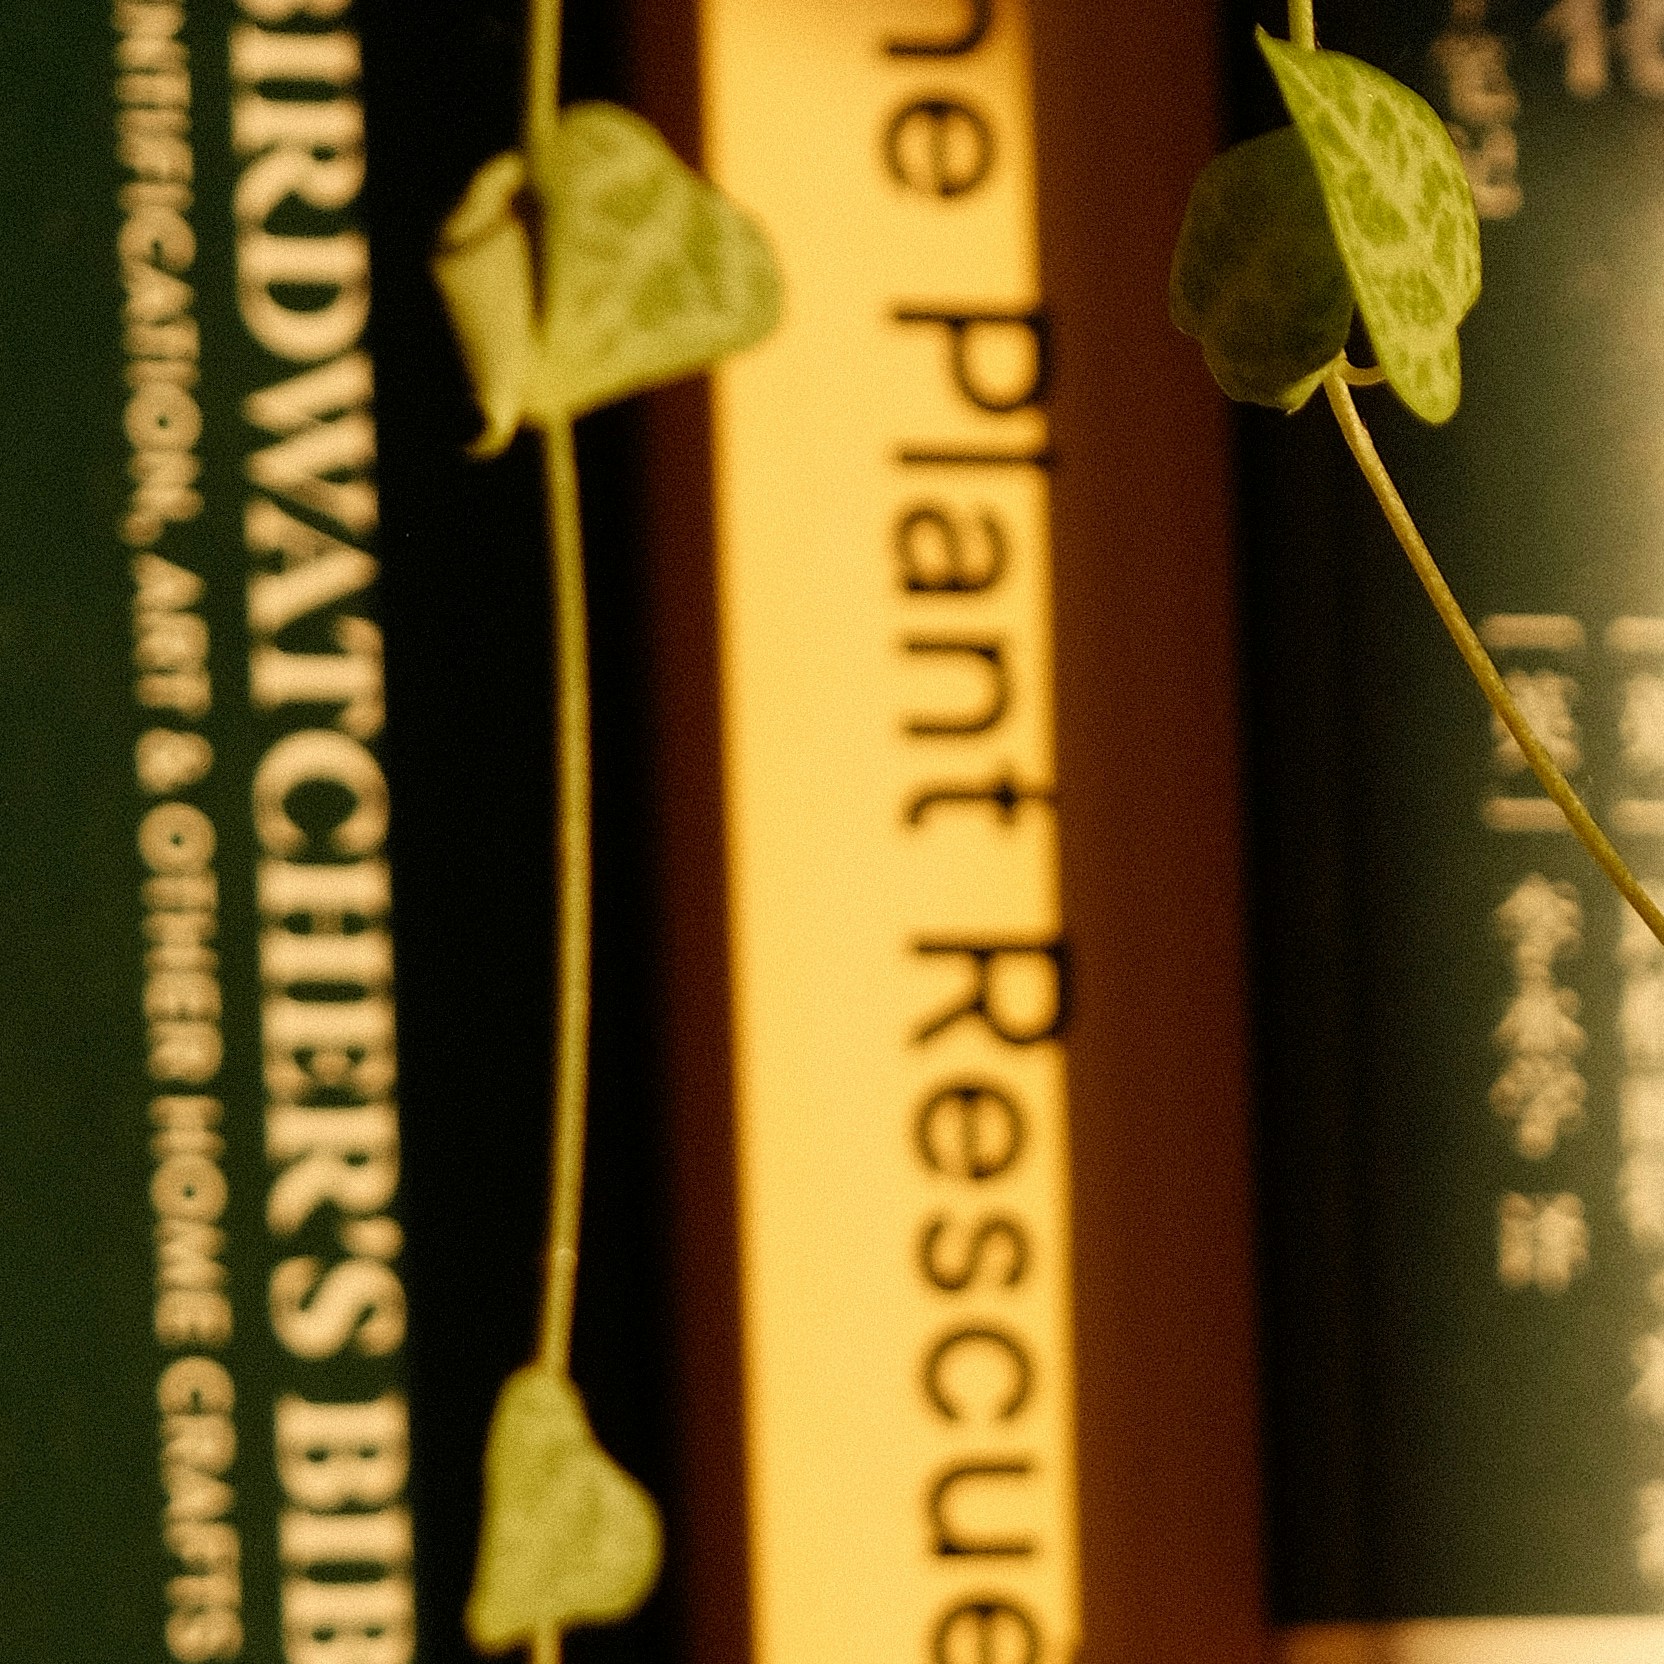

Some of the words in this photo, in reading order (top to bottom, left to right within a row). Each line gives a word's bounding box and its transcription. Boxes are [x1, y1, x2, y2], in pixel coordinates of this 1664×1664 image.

[133, 552, 211, 716] ART
[228, 0, 405, 1360] IRDWATCHER'S
[891, 300, 1056, 828] Plant
[134, 726, 213, 795] &
[137, 800, 223, 1084] OTHER
[148, 1093, 234, 1346] HOME
[156, 1354, 244, 1664] CRAFTS
